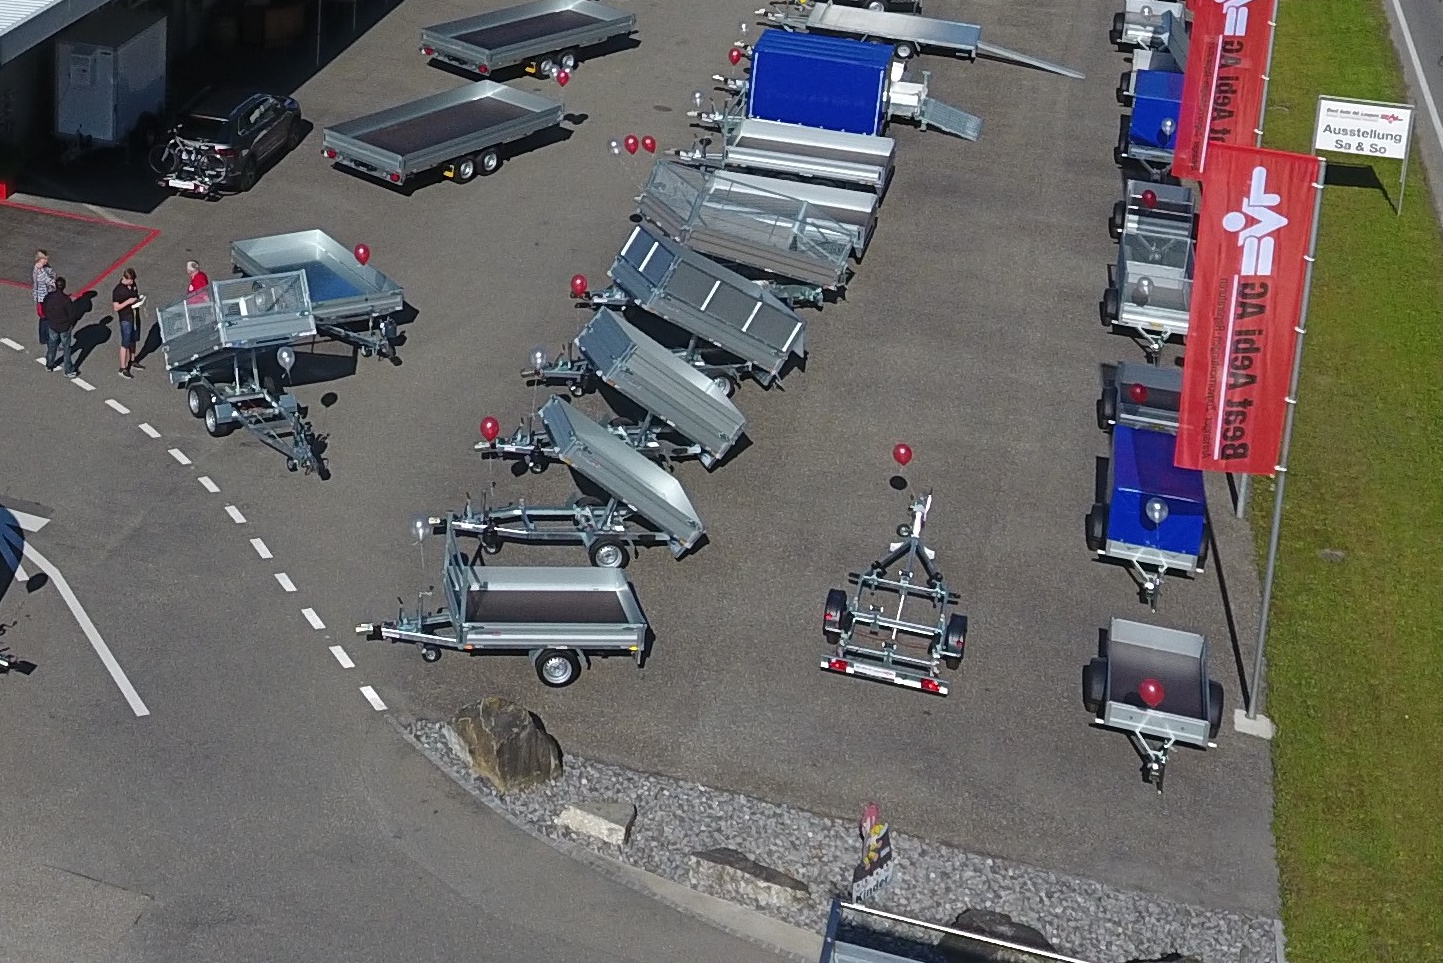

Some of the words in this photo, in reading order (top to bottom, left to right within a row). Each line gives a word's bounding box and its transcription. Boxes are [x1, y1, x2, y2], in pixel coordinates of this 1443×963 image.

[1323, 124, 1402, 143] Ausstellung
[1334, 139, 1351, 150] Sa
[1356, 142, 1364, 152] &
[1369, 143, 1387, 154] So
